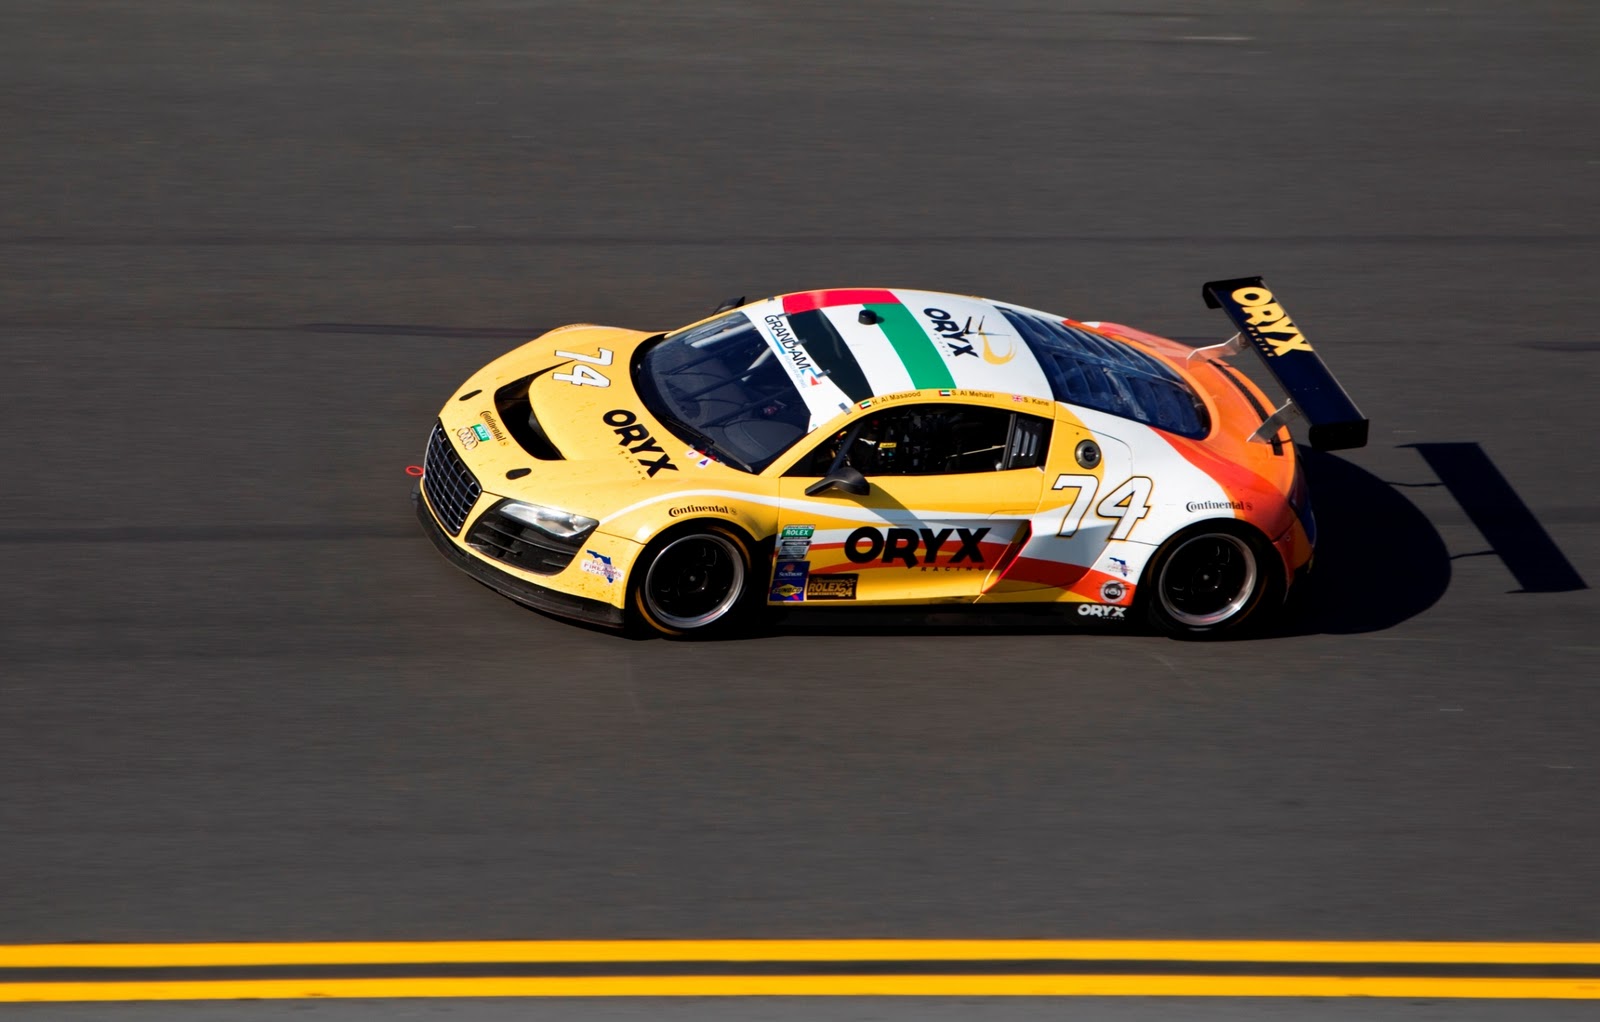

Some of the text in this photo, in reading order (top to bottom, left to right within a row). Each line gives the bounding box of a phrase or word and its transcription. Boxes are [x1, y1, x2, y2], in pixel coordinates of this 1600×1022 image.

[923, 307, 980, 359] ORYX
[1231, 286, 1314, 357] ORYX
[552, 347, 614, 388] 74
[602, 409, 680, 479] ORYX
[668, 504, 729, 518] Continental
[1051, 473, 1153, 542] 74
[1185, 500, 1245, 514] Continental
[844, 526, 992, 569] ORYX
[808, 582, 841, 592] ROLEX
[920, 565, 987, 573] RACING
[1077, 603, 1127, 618] ORYX
